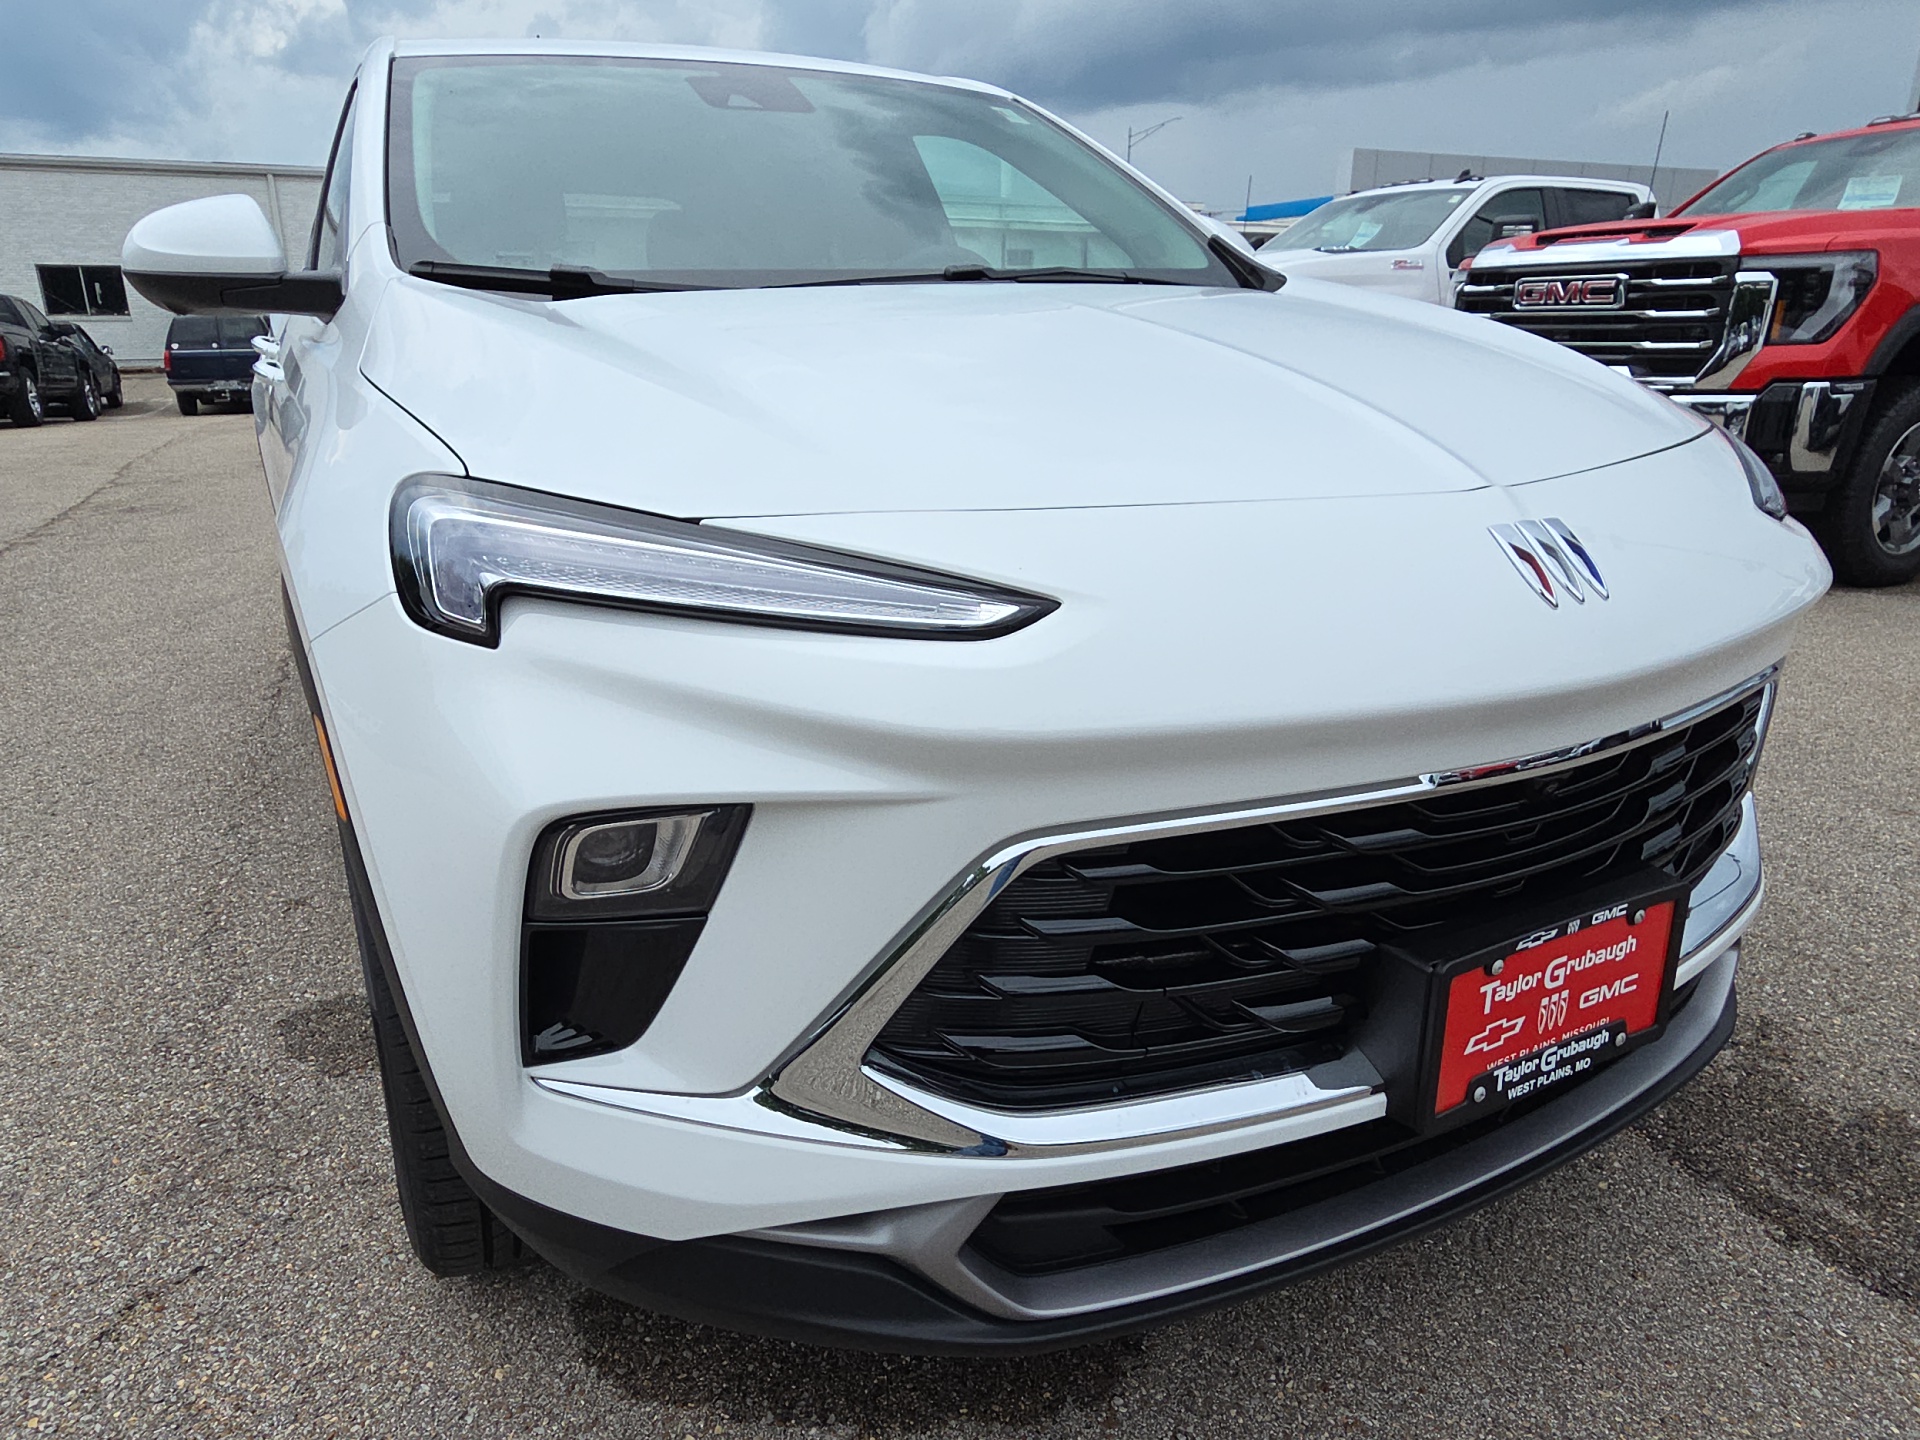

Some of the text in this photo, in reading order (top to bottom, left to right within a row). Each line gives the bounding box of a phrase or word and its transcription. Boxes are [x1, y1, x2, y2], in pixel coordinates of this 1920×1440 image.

[1519, 280, 1617, 304] GMC
[1591, 903, 1628, 925] GMC
[1480, 935, 1637, 1015] Taylor Grubaugh
[1579, 973, 1639, 1009] GMC
[1493, 1029, 1610, 1092] Taylor Grubaugh
[1507, 1057, 1591, 1100] WEST PLAINS, MO
